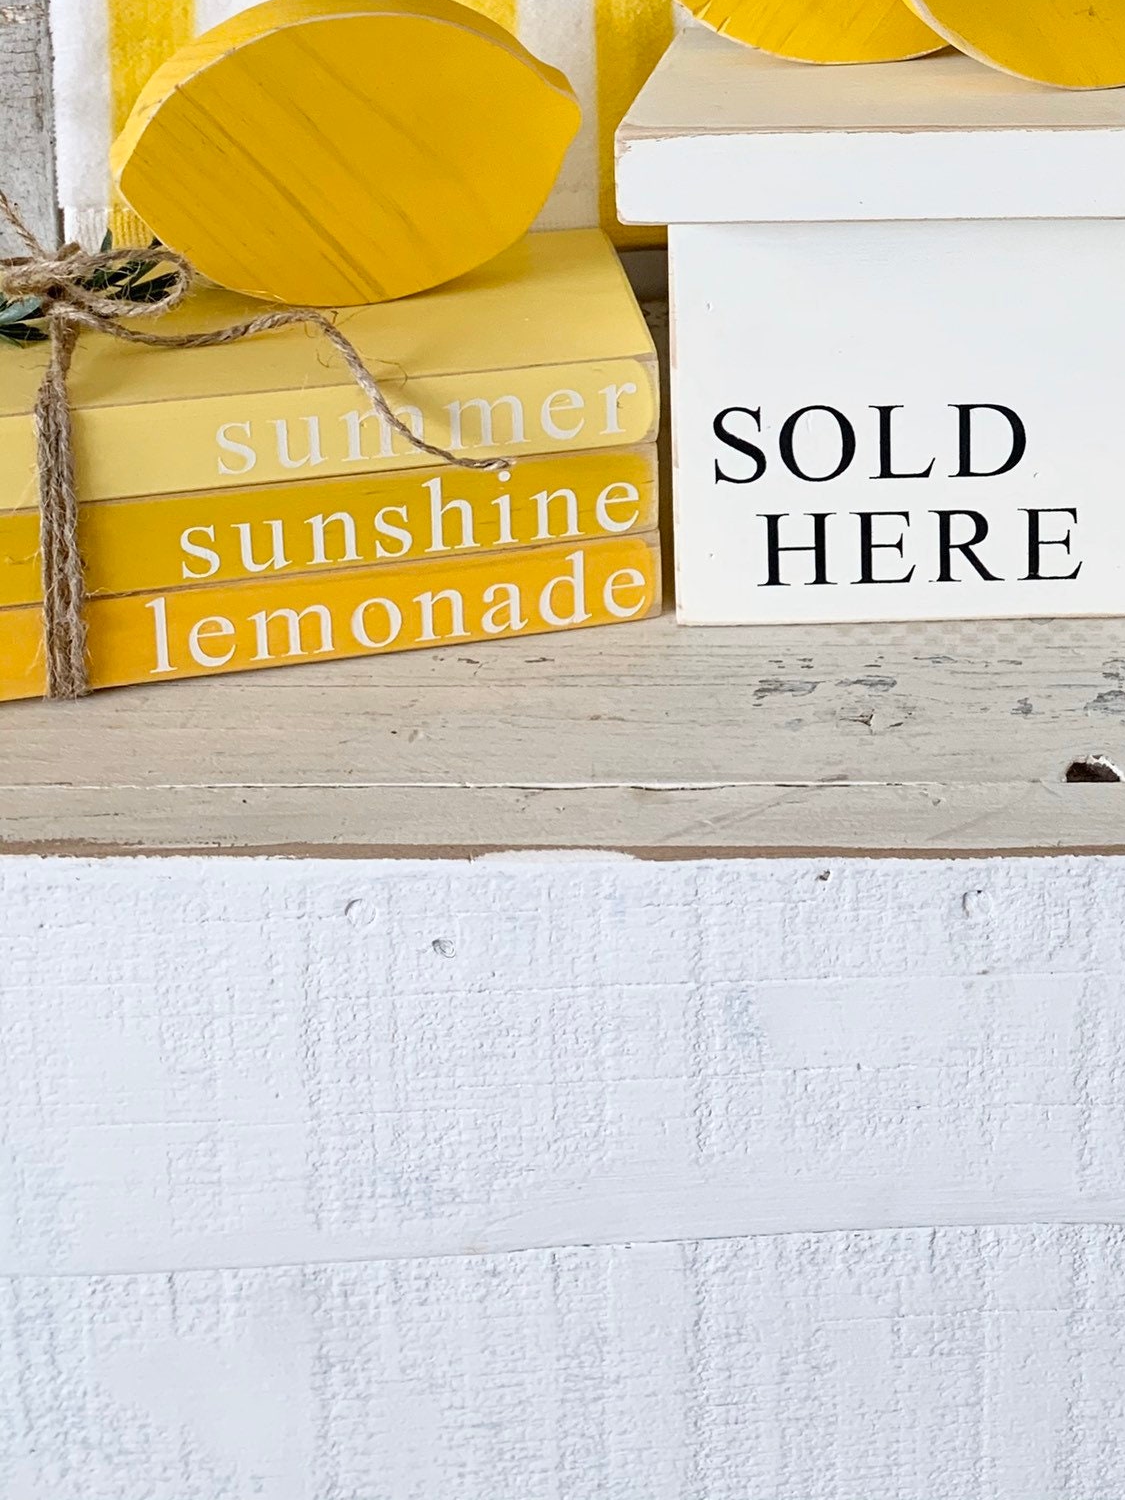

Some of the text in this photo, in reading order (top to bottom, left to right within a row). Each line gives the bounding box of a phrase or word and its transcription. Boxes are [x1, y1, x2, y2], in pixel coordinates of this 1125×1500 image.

[216, 381, 637, 474] summer
[713, 403, 1027, 485] SOLD
[179, 472, 641, 579] sunshine
[757, 508, 1083, 588] HERE
[145, 551, 647, 674] lemonade
